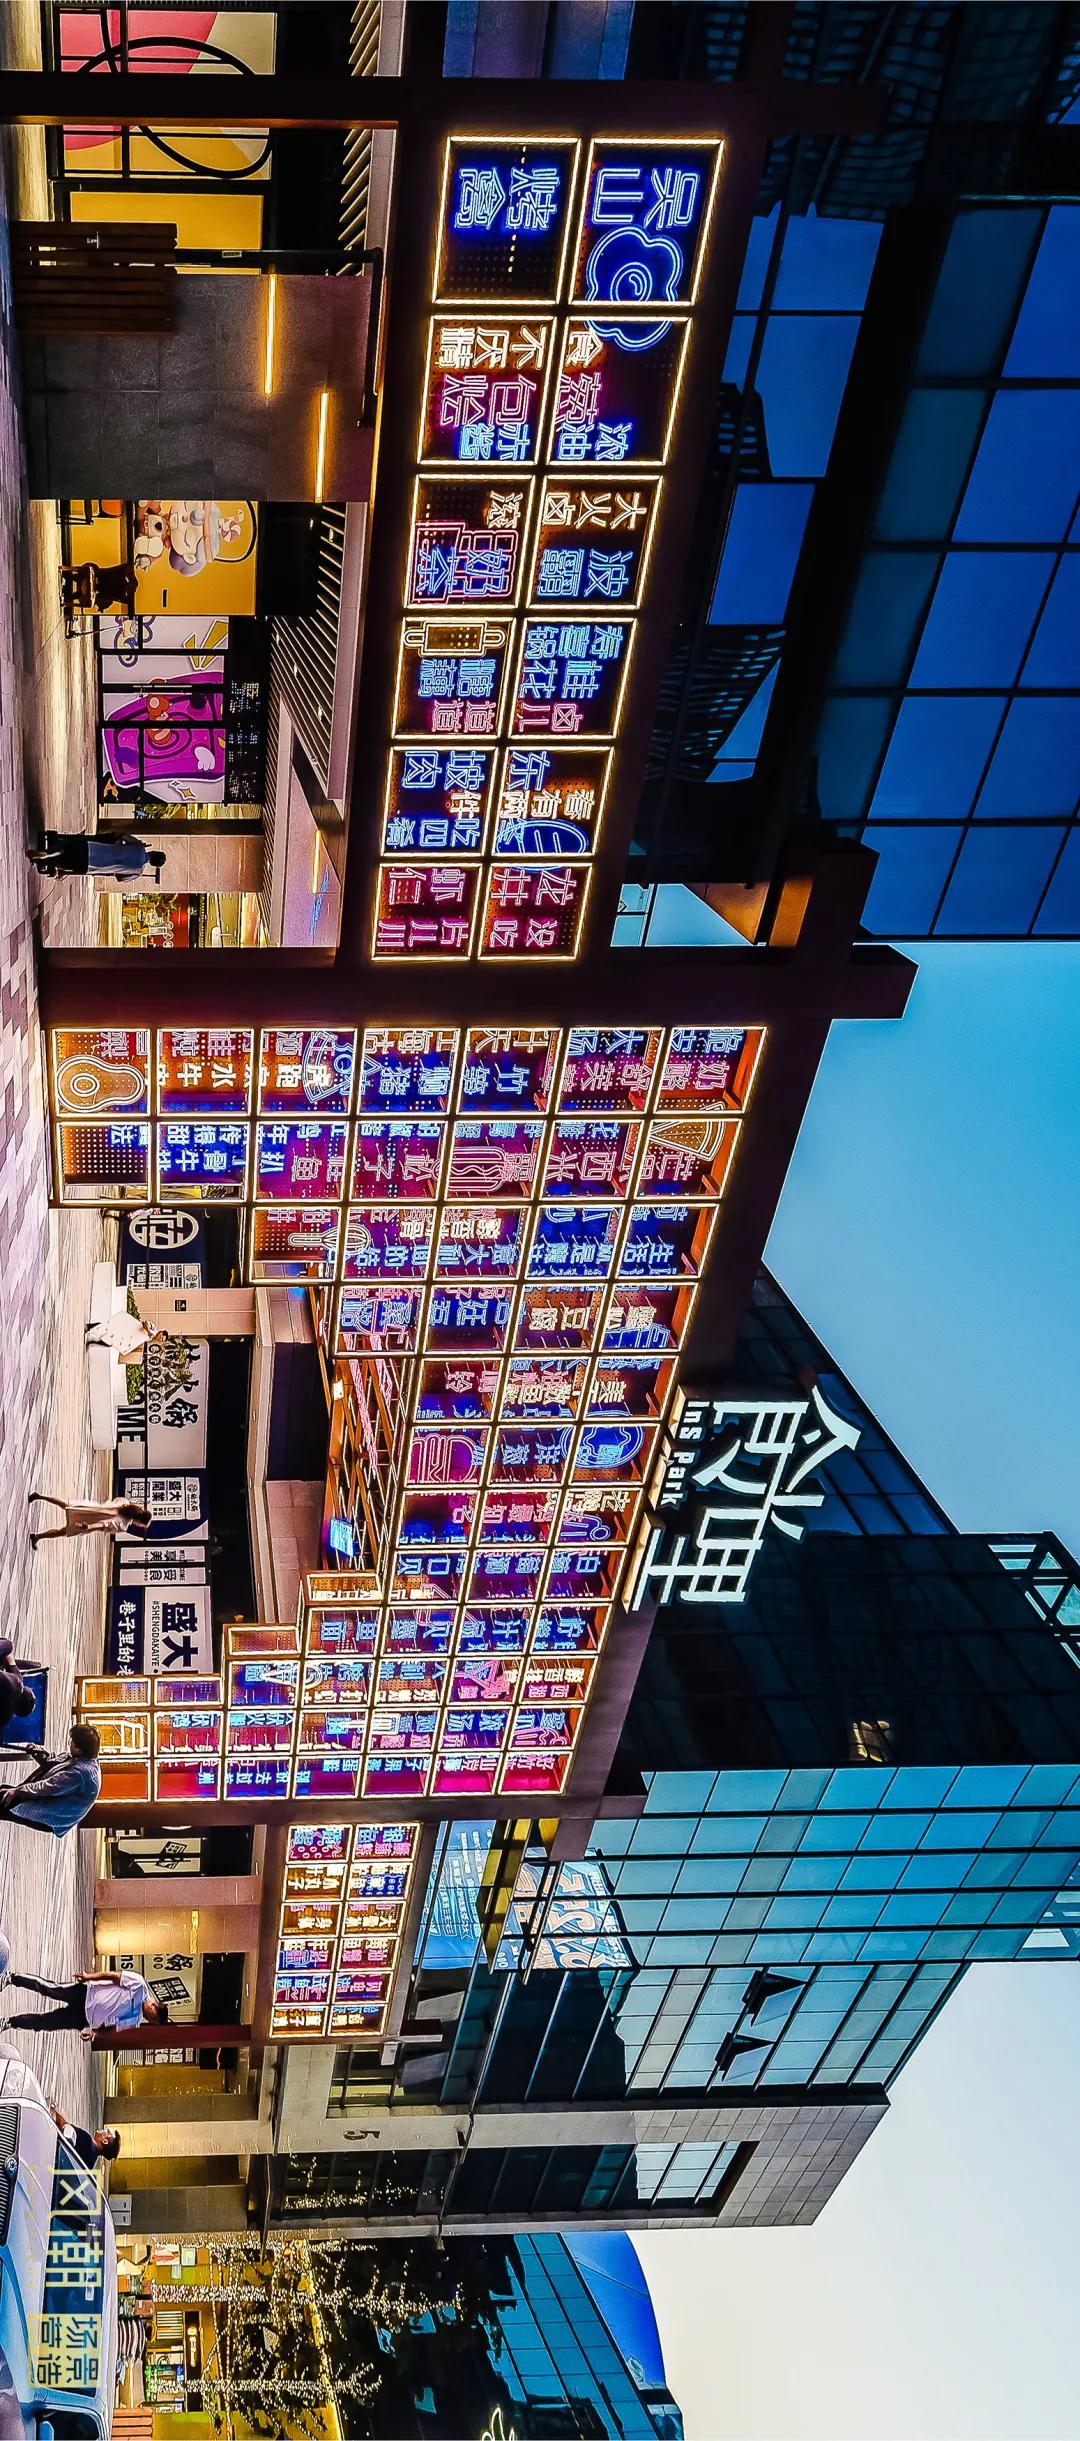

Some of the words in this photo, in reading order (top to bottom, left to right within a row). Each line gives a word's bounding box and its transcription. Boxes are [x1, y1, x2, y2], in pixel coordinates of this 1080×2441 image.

[524, 625, 624, 660] 寿喜锅
[659, 1451, 696, 1506] Park
